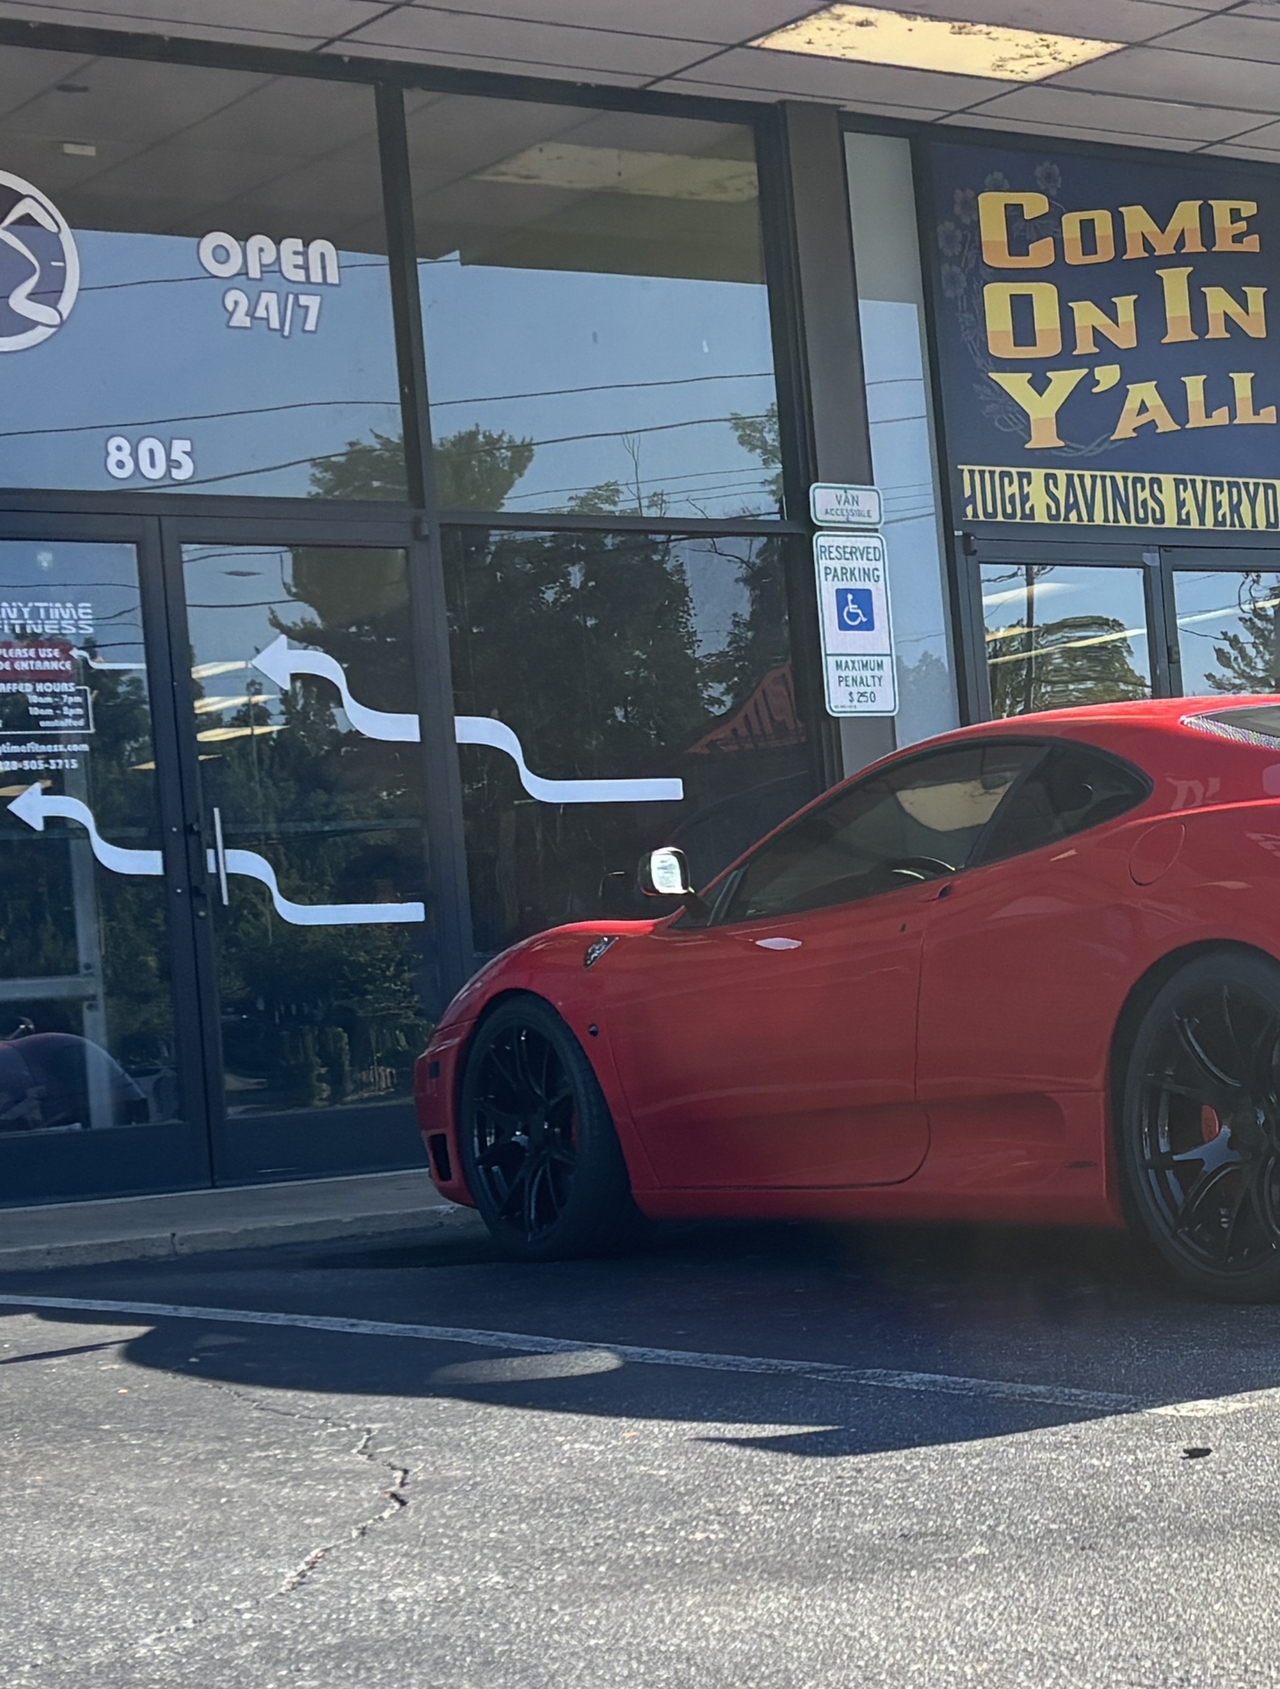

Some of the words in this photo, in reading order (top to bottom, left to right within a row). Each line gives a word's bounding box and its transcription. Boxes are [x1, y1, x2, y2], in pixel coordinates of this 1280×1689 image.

[199, 231, 340, 284] OPEN
[224, 289, 322, 337] 24/7
[105, 436, 194, 480] 805
[835, 493, 860, 507] VAN
[962, 469, 1035, 521] HUGE
[1044, 472, 1166, 525] SAVINGS
[824, 508, 872, 518] ACCESSIBLE
[819, 545, 881, 561] RESERVED
[824, 567, 880, 583] PARKING
[0, 602, 93, 619] NYTIME
[0, 620, 94, 634] ITNESS
[38, 648, 60, 658] USE
[13, 661, 72, 671] ENTRANCE
[835, 659, 885, 672] MAXIMUM
[35, 682, 76, 692] HOURS
[838, 675, 882, 688] PENALTY
